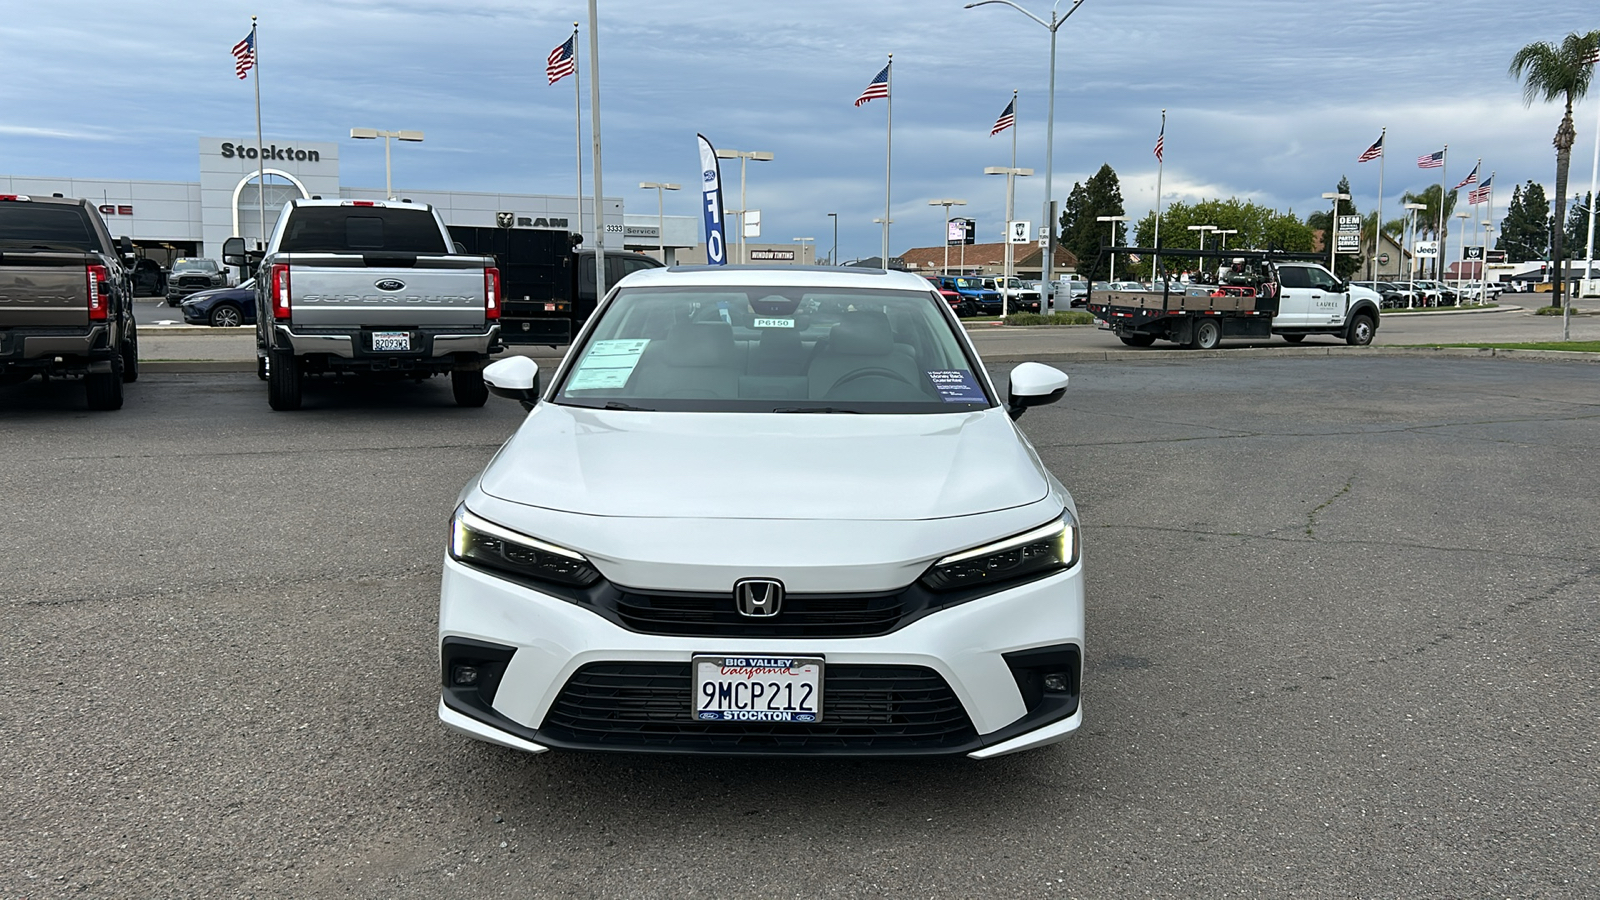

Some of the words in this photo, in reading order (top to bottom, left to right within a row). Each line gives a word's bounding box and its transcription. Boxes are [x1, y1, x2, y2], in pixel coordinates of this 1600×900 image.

[221, 142, 319, 162] Stockton
[517, 217, 568, 228] RAM
[1339, 216, 1360, 224] OEM
[606, 224, 623, 232] 3333
[752, 251, 774, 259] WINDOW
[1416, 247, 1437, 255] Jeep
[302, 294, 399, 303] SUPER
[405, 295, 476, 304] DUTY
[725, 658, 746, 666] BIG
[749, 659, 792, 667] VALLEY
[702, 681, 813, 712] 9MCP212
[723, 711, 792, 721] STOCKTON
